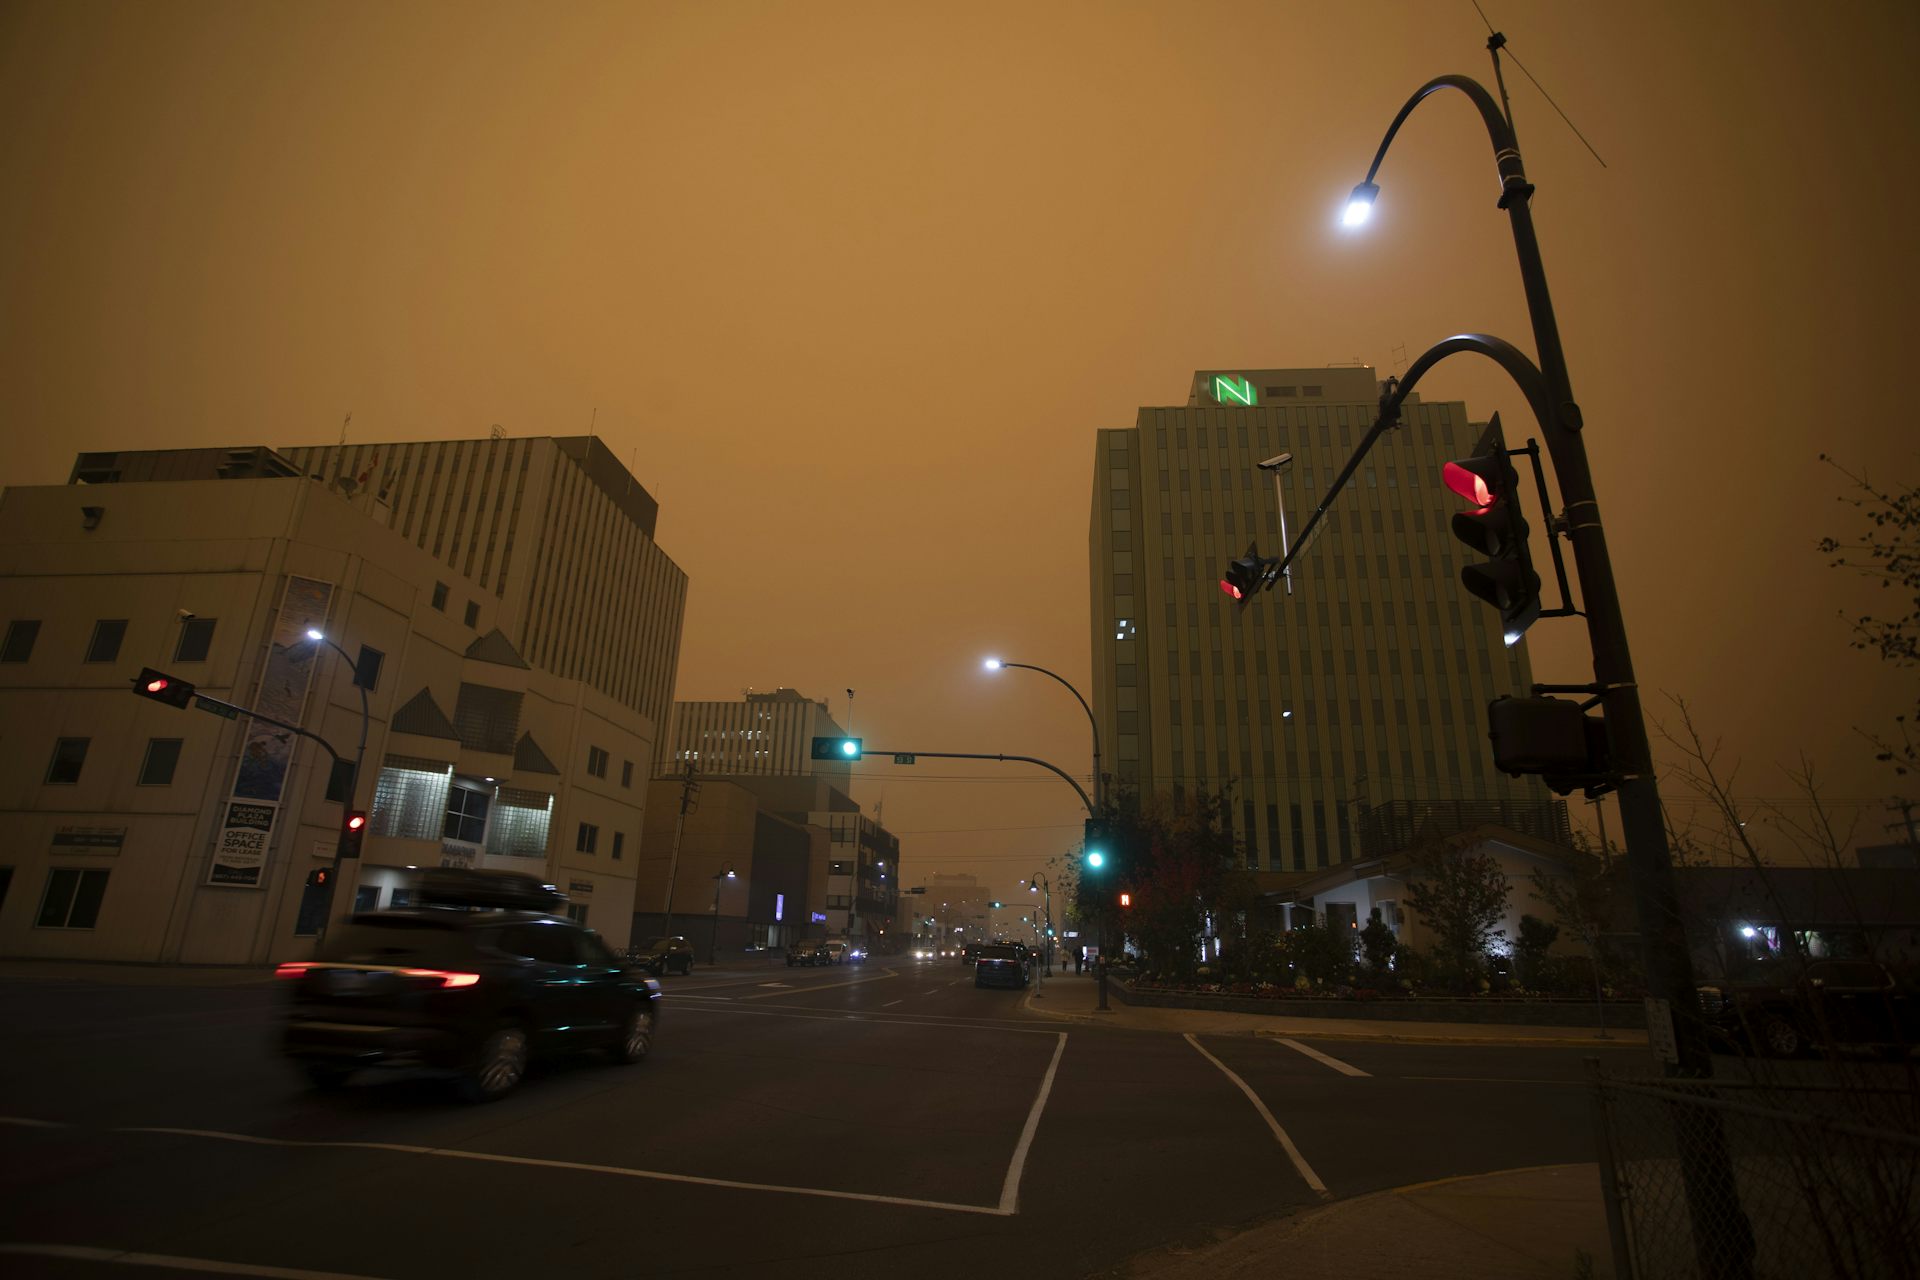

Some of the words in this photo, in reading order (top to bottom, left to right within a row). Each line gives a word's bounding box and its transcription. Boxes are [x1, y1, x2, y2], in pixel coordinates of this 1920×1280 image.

[1211, 374, 1257, 406] N
[232, 806, 272, 815] DIAMOND
[238, 812, 264, 820] PLAZA
[230, 817, 269, 826] BUILDING
[226, 830, 266, 841] OFFICE
[224, 838, 265, 850] SPACE
[238, 848, 262, 856] LEASE
